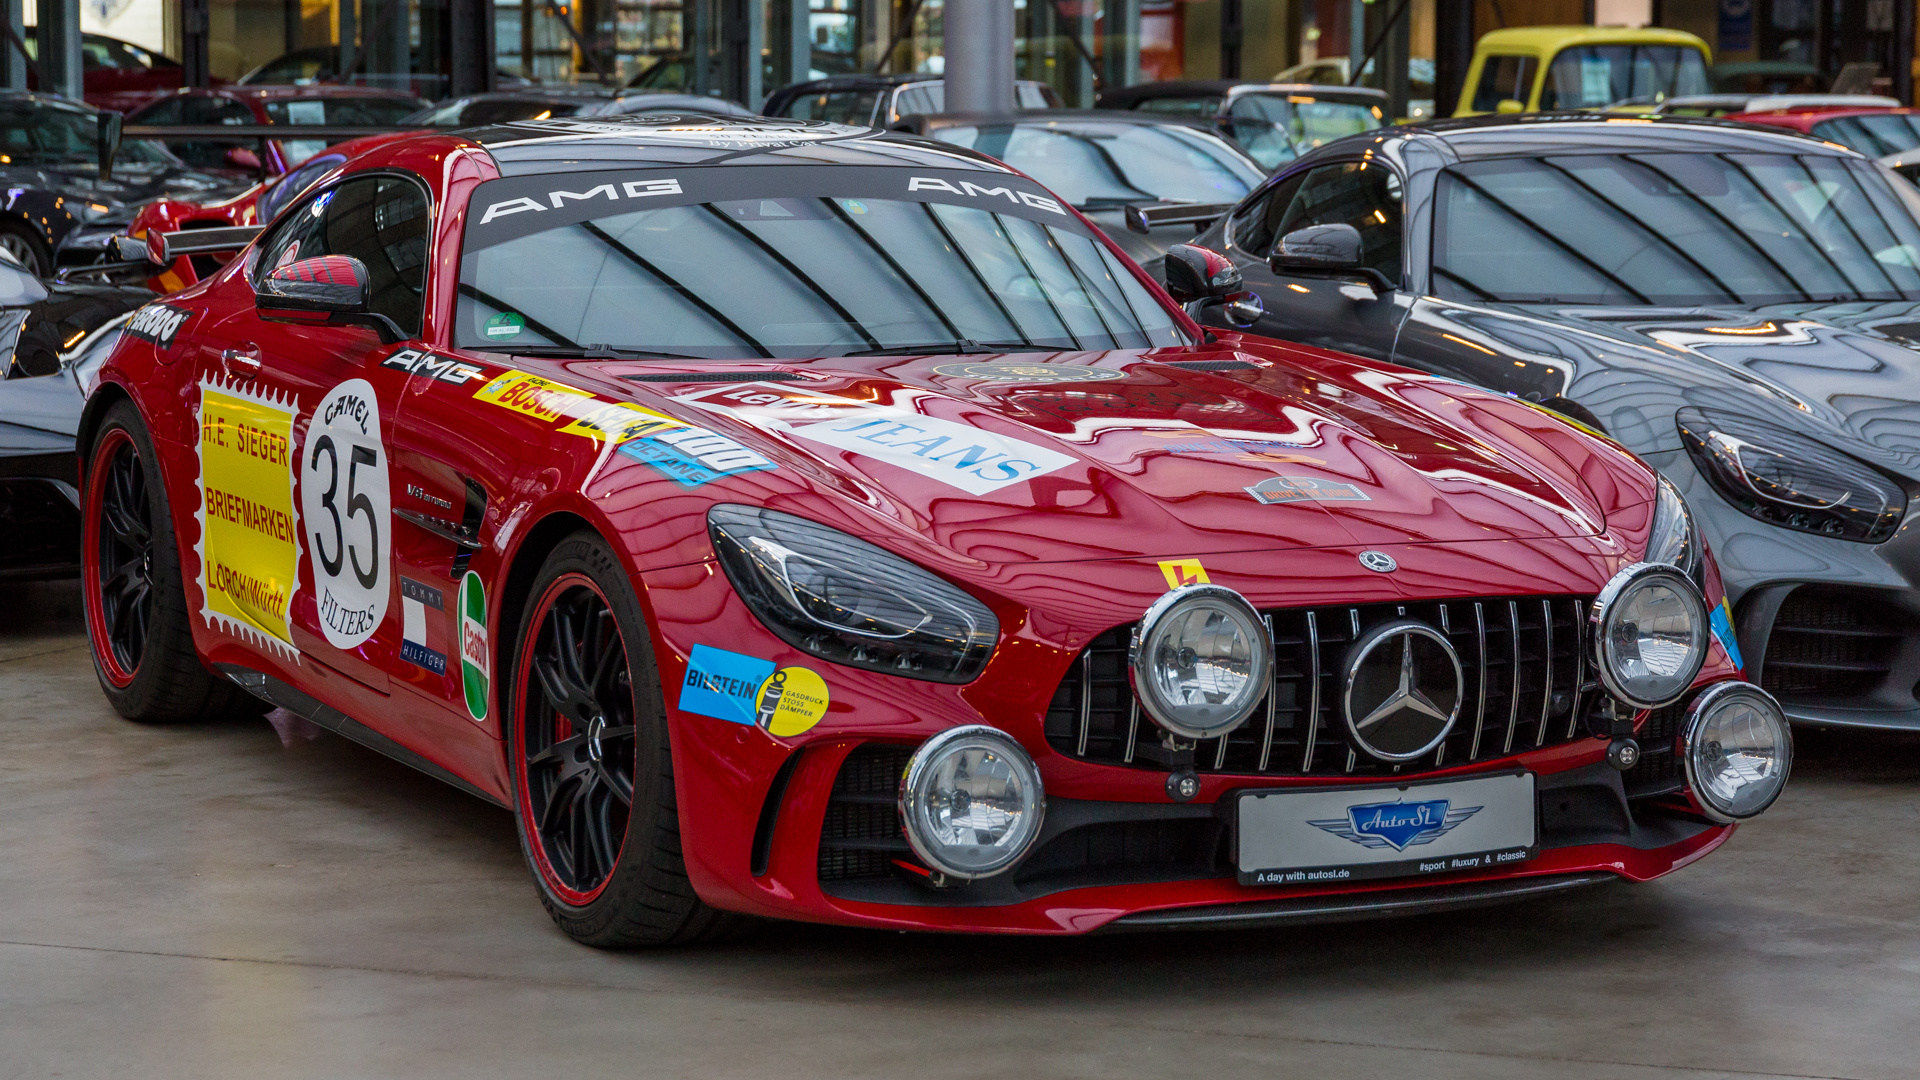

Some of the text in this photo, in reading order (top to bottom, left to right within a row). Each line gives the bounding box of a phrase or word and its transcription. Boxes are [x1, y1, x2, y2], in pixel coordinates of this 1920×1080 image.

[479, 178, 684, 225] AMG
[908, 176, 1067, 216] AMG
[499, 313, 511, 326] 4
[383, 349, 483, 384] AMG
[324, 394, 368, 435] CAMEL
[497, 381, 577, 419] BOSCH
[203, 413, 287, 467] H.E. SIEGER
[654, 428, 770, 471] 100
[832, 418, 1042, 481] JEANS
[1163, 442, 1213, 453] GIVE
[1209, 440, 1253, 450] FOR
[626, 441, 709, 482] OCTANE
[407, 483, 424, 499] V8
[1262, 489, 1299, 500] DRIVE
[1297, 488, 1323, 497] FOR
[1321, 488, 1356, 497] GOOD
[206, 486, 294, 545] BRIEFMARKEN
[311, 434, 379, 590] 35
[321, 585, 375, 636] FILTERS
[403, 581, 442, 606] TOMMY
[403, 644, 445, 670] HILFIGER
[464, 621, 488, 671] Castrol
[686, 669, 757, 700] BILSTEIN
[783, 697, 804, 707] STOSS
[785, 690, 824, 706] GASDRUCK
[1361, 809, 1406, 831] Auto
[1257, 868, 1350, 884] A day with autosl.de
[1419, 850, 1526, 873] #sport #luxury & #classic
